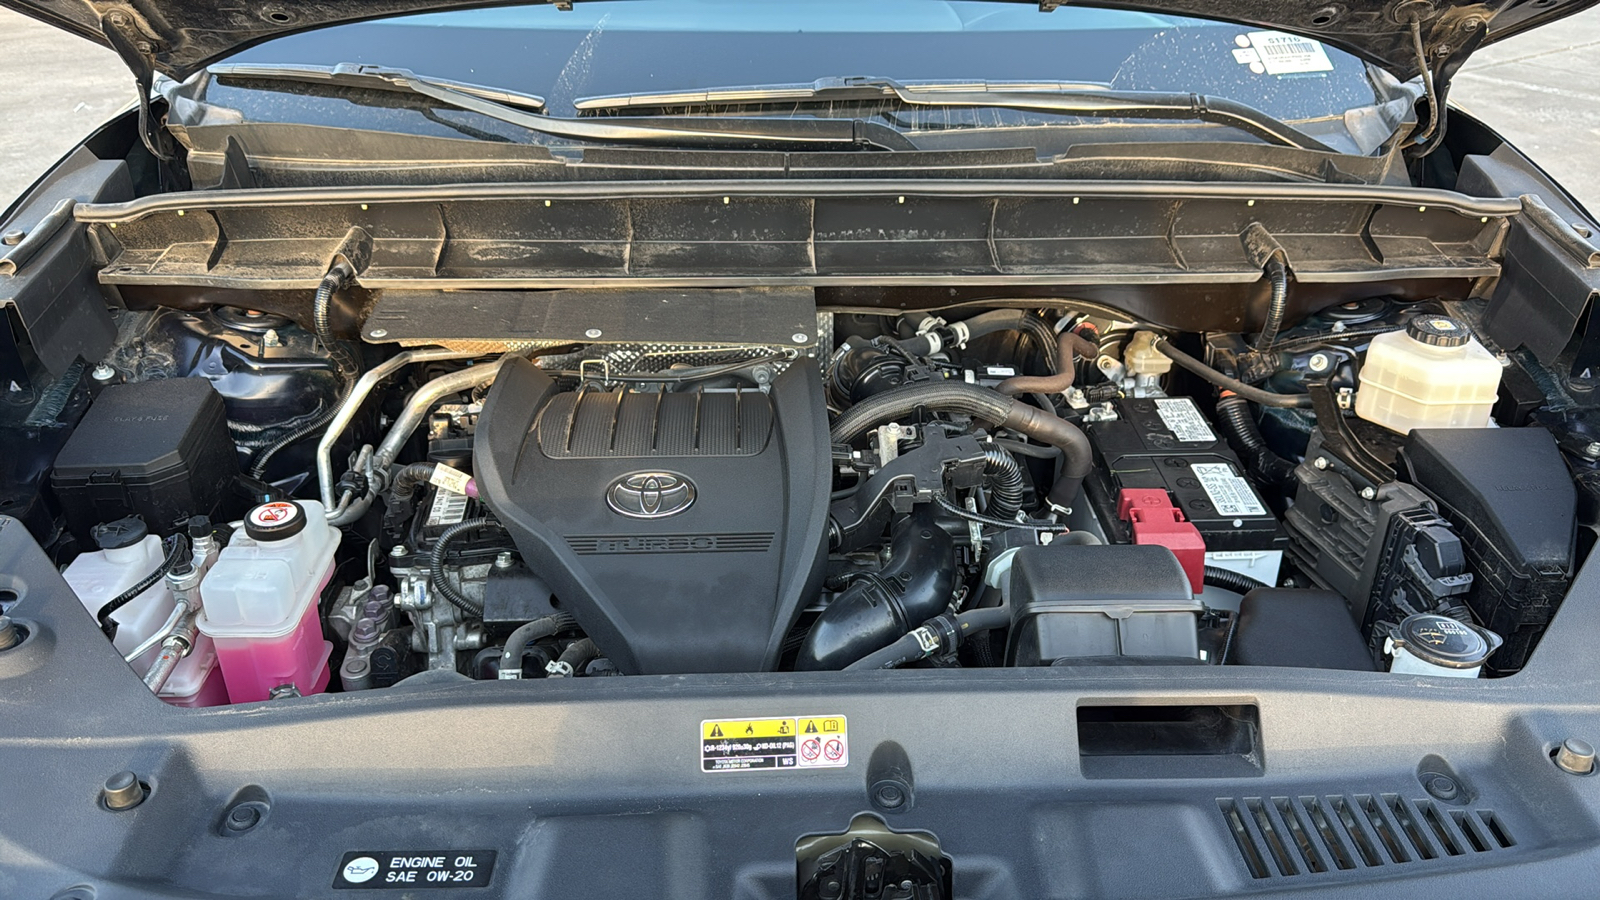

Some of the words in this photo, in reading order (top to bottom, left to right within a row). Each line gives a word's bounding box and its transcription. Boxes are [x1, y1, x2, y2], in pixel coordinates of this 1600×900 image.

[599, 536, 714, 550] TURBO
[782, 757, 794, 765] WS
[389, 856, 446, 868] ENGINE
[454, 856, 478, 867] OIL
[385, 871, 418, 882] SAE
[426, 870, 474, 882] 0W-20
